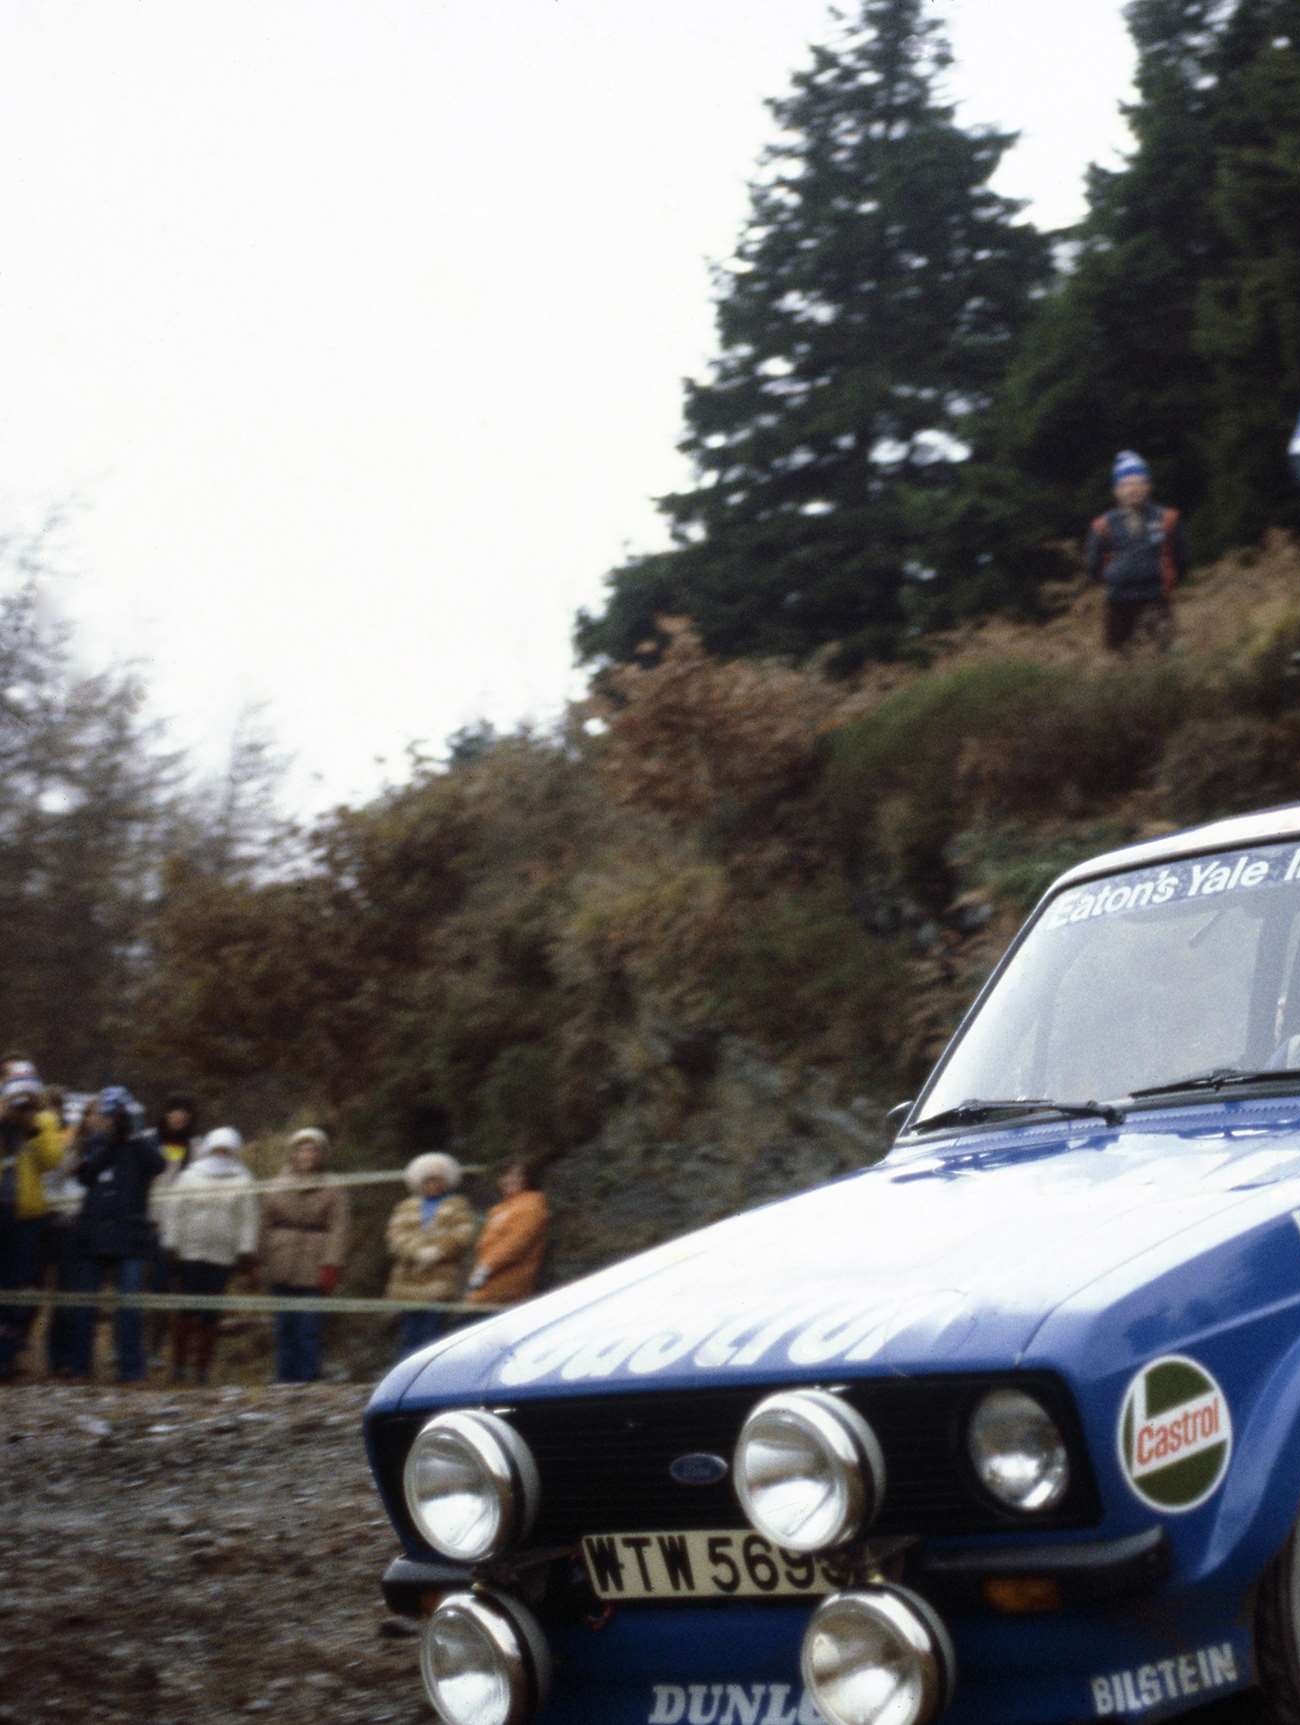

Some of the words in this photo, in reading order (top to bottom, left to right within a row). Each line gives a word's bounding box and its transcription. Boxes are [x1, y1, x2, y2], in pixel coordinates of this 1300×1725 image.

[1186, 856, 1267, 897] Yale
[1136, 1397, 1221, 1466] Castrol
[583, 1535, 696, 1593] WTW
[1089, 1642, 1240, 1717] BILSTEIN
